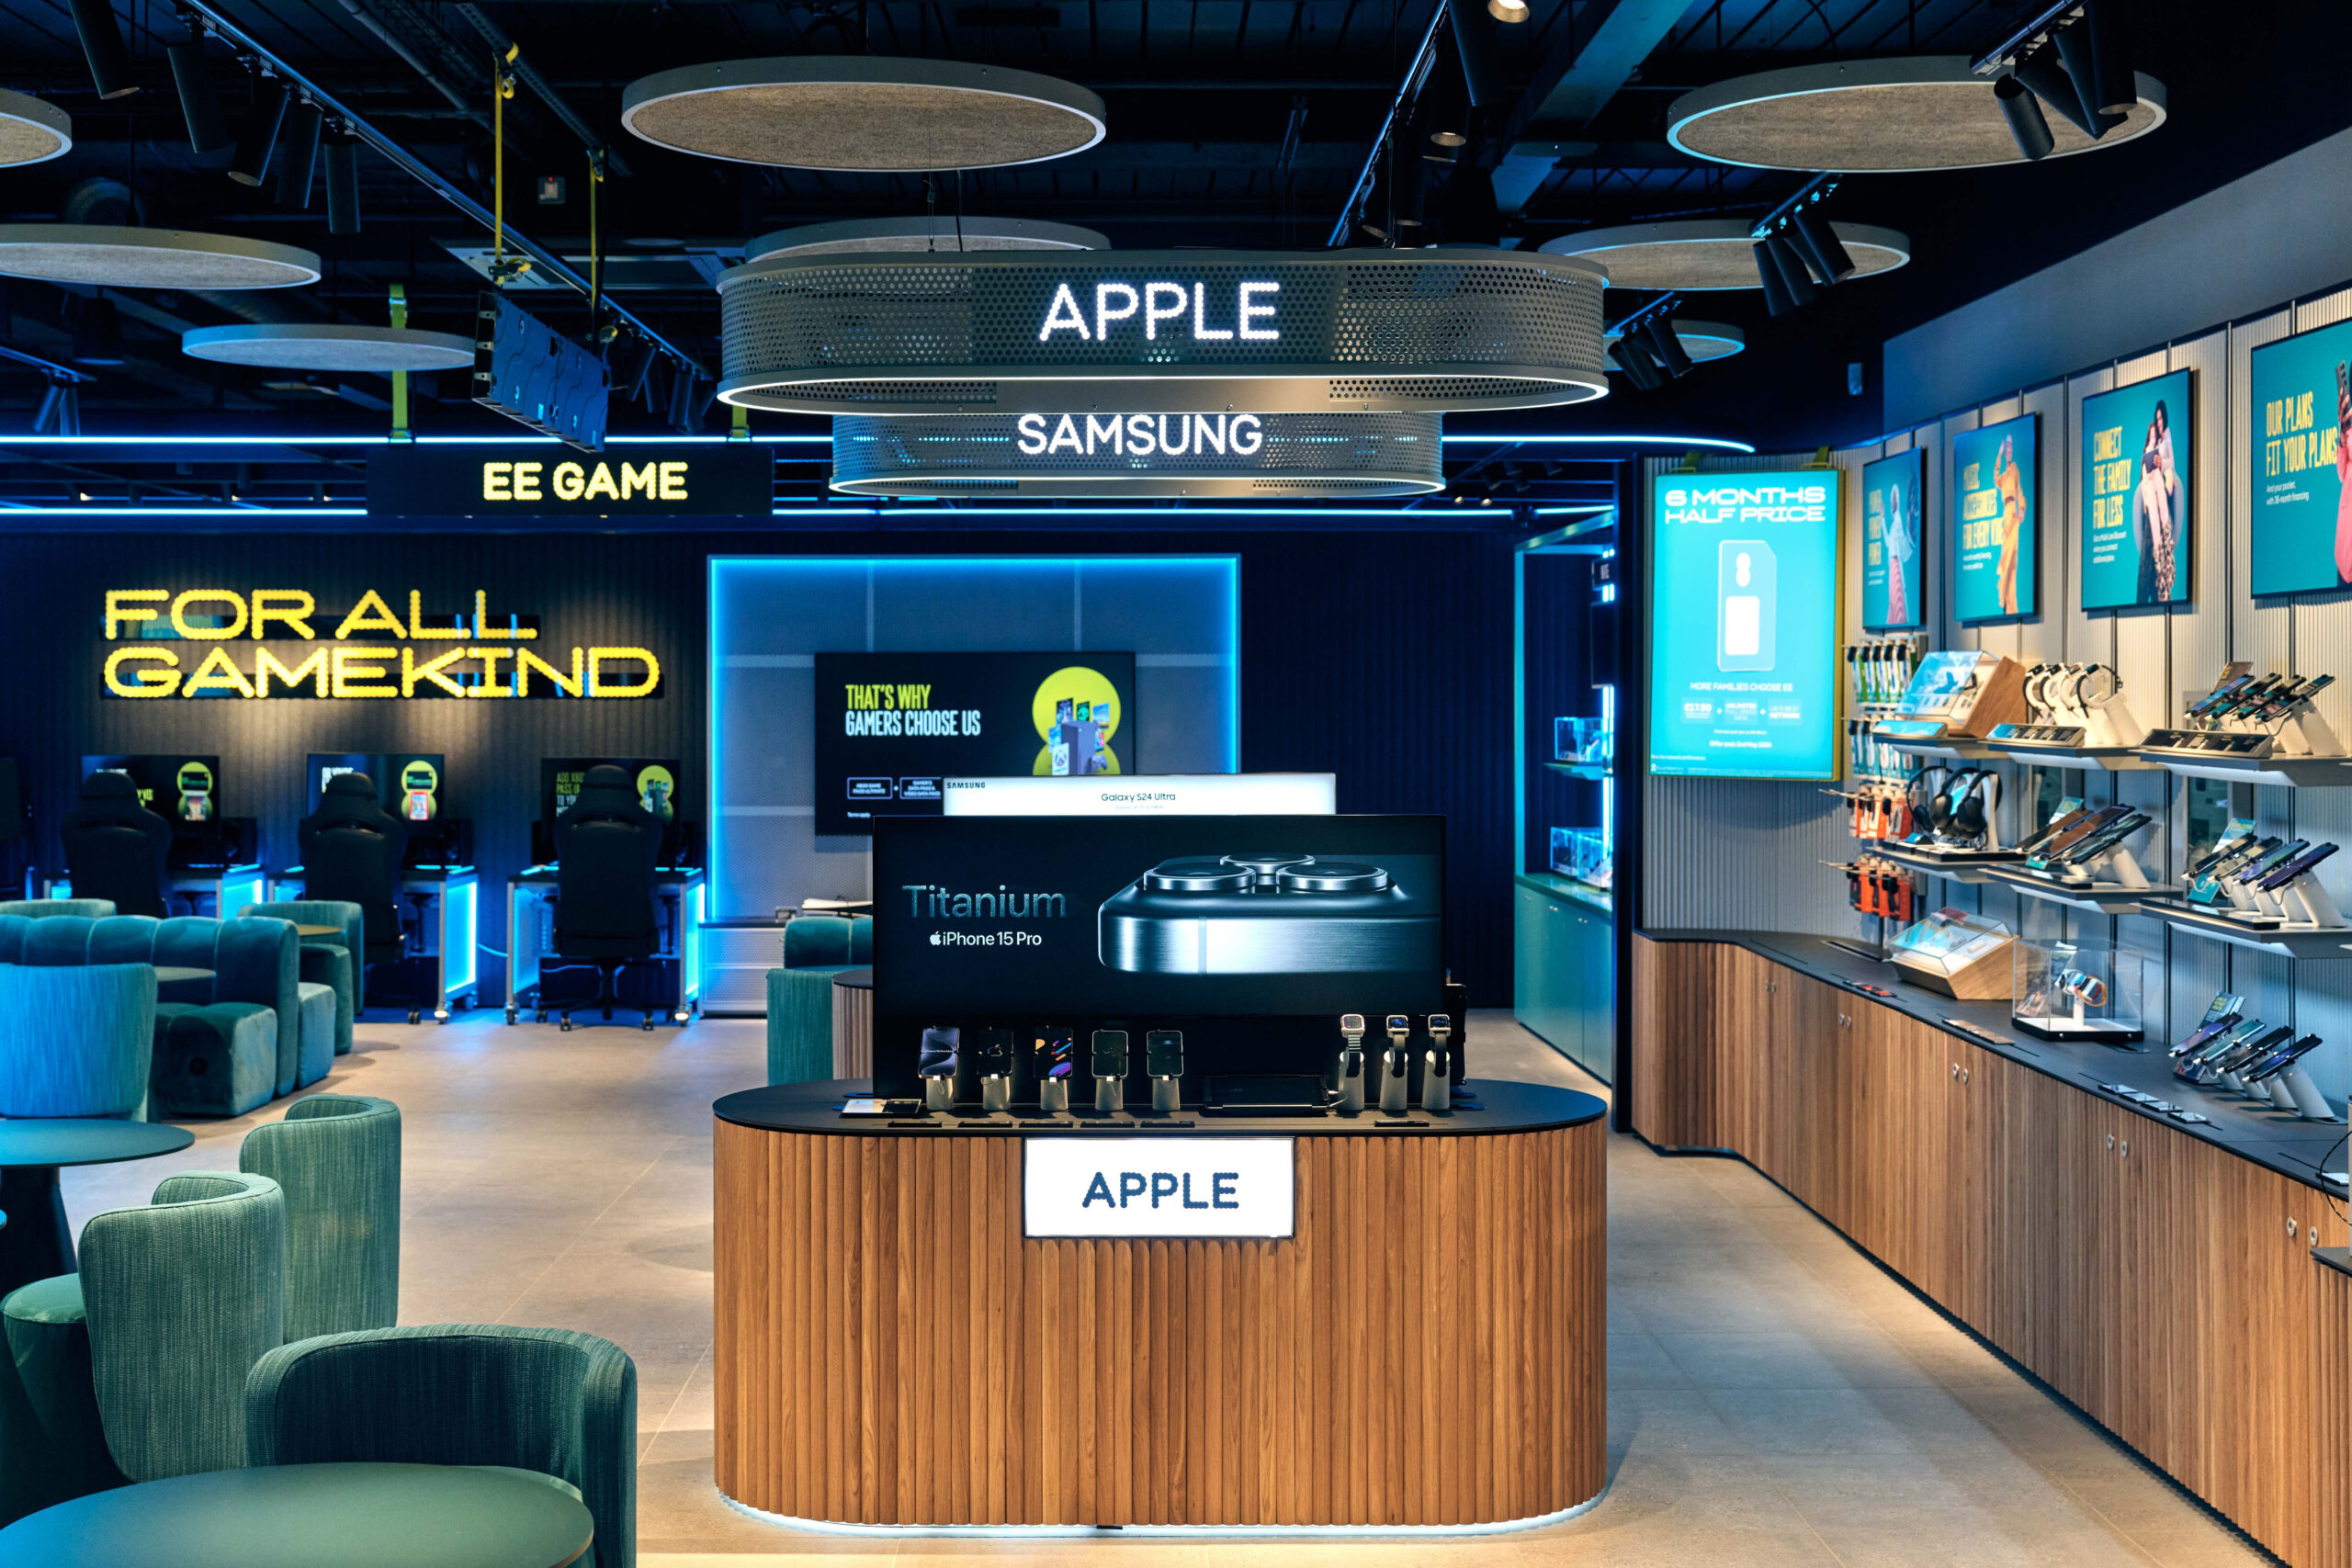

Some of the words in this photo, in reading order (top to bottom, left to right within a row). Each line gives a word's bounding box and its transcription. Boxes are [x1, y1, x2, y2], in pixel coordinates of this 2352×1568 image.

[1039, 282, 1280, 342] APPLE
[2267, 400, 2283, 437] OUR
[2285, 390, 2313, 433] PLANS
[1017, 413, 1263, 456] SAMSUNG
[2093, 426, 2122, 462] CONNECT
[2267, 440, 2281, 477] FIT
[2283, 434, 2306, 473] YOUR
[2309, 426, 2337, 468] PLANS
[483, 462, 542, 502] EE
[553, 461, 689, 502] GAME
[2093, 464, 2106, 495] THE
[2107, 458, 2132, 493] FAMILY
[1665, 490, 1687, 506] 6
[1691, 486, 1826, 505] MONTHS
[2093, 498, 2105, 529] FOR
[2107, 494, 2123, 527] LESS
[1665, 507, 1736, 525] HALF
[1740, 505, 1826, 523] PRICE
[105, 590, 315, 639] FOR
[335, 589, 538, 639] ALL
[104, 647, 661, 698] GAMEKIND
[1690, 682, 1712, 691] MORE
[1713, 682, 1748, 692] FAMILIES
[1749, 683, 1781, 692] CHOOSE
[1782, 683, 1793, 692] EE
[845, 683, 895, 710] THAT'S
[897, 683, 931, 710] WHY
[845, 710, 902, 736] GAMERS
[905, 710, 959, 736] CHOOSE
[961, 710, 981, 736] US
[1102, 793, 1136, 803] Galaxy
[1136, 793, 1152, 801] S24
[1154, 793, 1176, 801] Ultra
[901, 885, 1066, 918] Titanium
[943, 931, 995, 946] iPhone
[997, 931, 1013, 946] 15
[1016, 931, 1042, 946] Pro
[1082, 1172, 1239, 1209] APPLE
